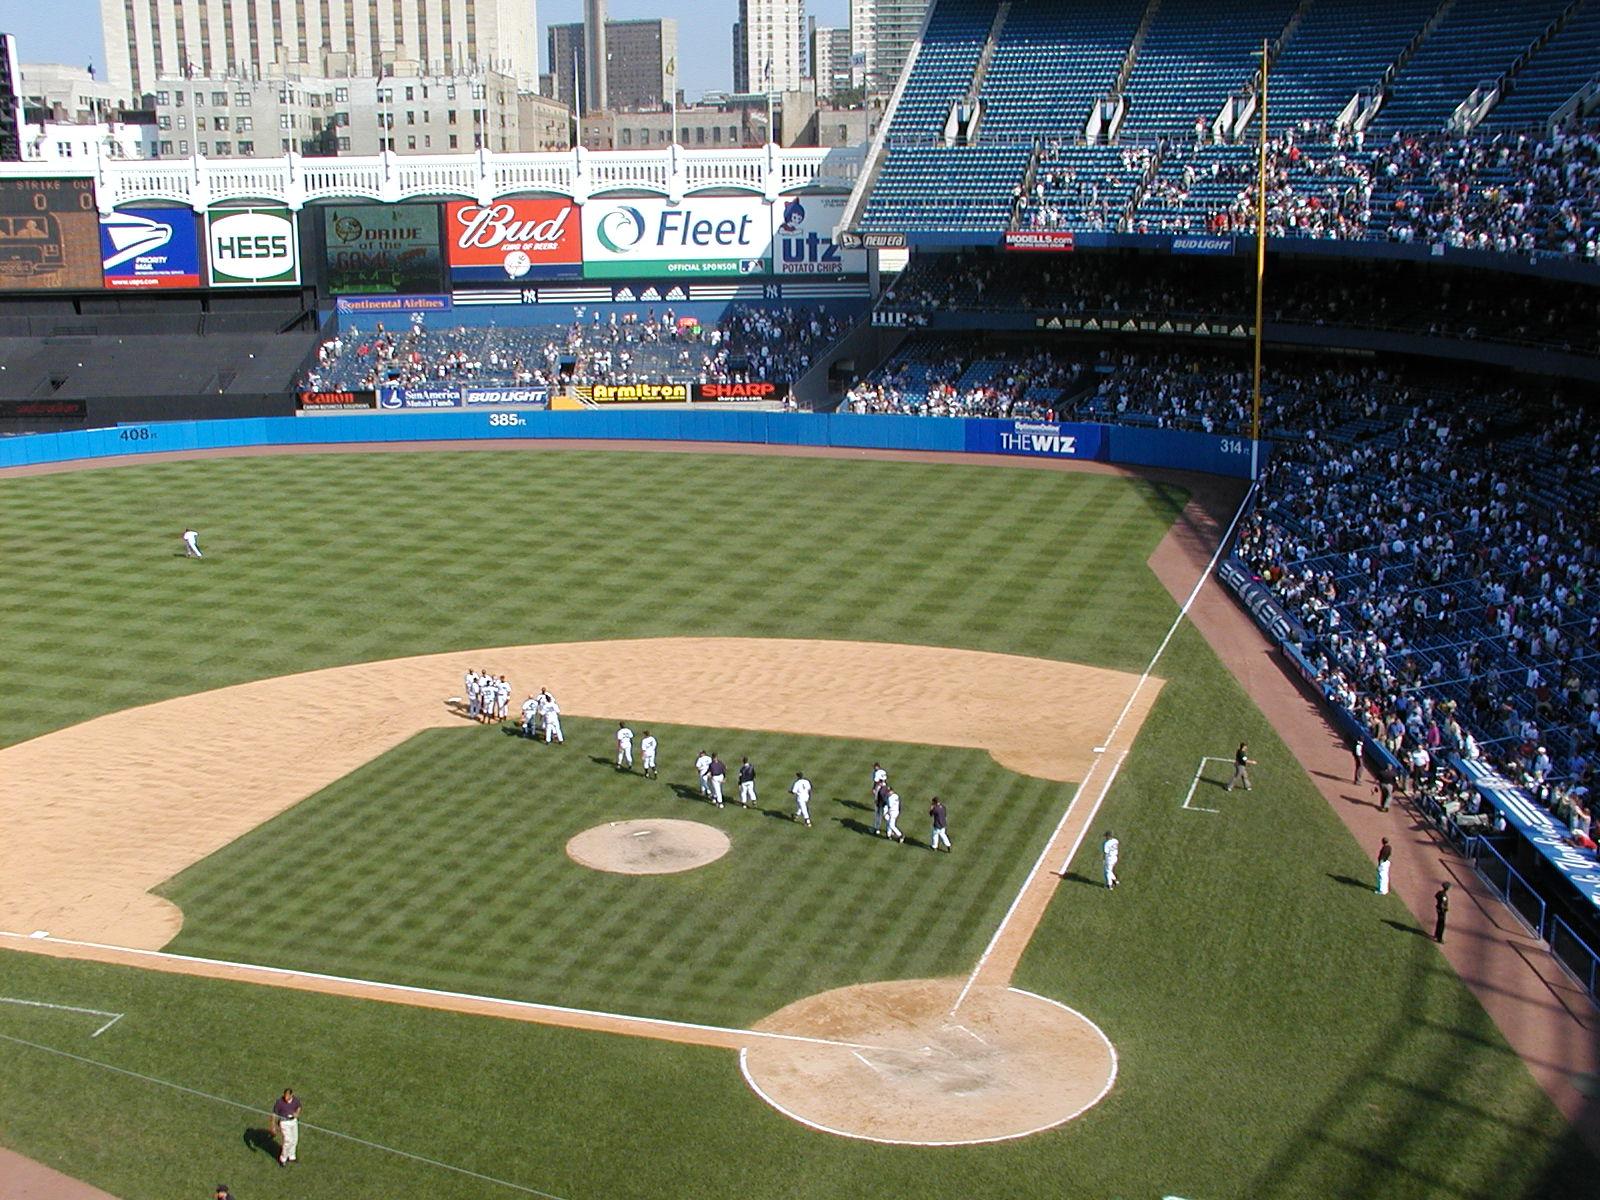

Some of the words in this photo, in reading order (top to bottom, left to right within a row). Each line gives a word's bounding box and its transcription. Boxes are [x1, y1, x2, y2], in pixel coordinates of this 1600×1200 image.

[16, 180, 61, 190] STRIKE
[34, 193, 47, 210] 0
[79, 192, 93, 210] 0
[456, 204, 572, 249] Bud
[656, 210, 752, 246] Fleet
[365, 228, 423, 241] DRIVE
[217, 236, 288, 259] HESS
[1173, 239, 1198, 249] BUD
[1197, 240, 1231, 250] LIGHT
[667, 263, 700, 271] OFFICIAL
[702, 262, 737, 271] SPONSOR
[782, 263, 815, 273] POTATO
[816, 262, 843, 273] CHIPS
[340, 299, 400, 310] Continental
[403, 299, 444, 309] Airlines
[468, 392, 501, 402] BUD
[501, 391, 547, 402] LIGHT
[593, 384, 686, 398] Armitron
[702, 383, 775, 397] SHARP
[301, 392, 354, 404] Canon
[489, 413, 518, 426] 385
[120, 428, 149, 441] 408
[1220, 438, 1242, 455] 314
